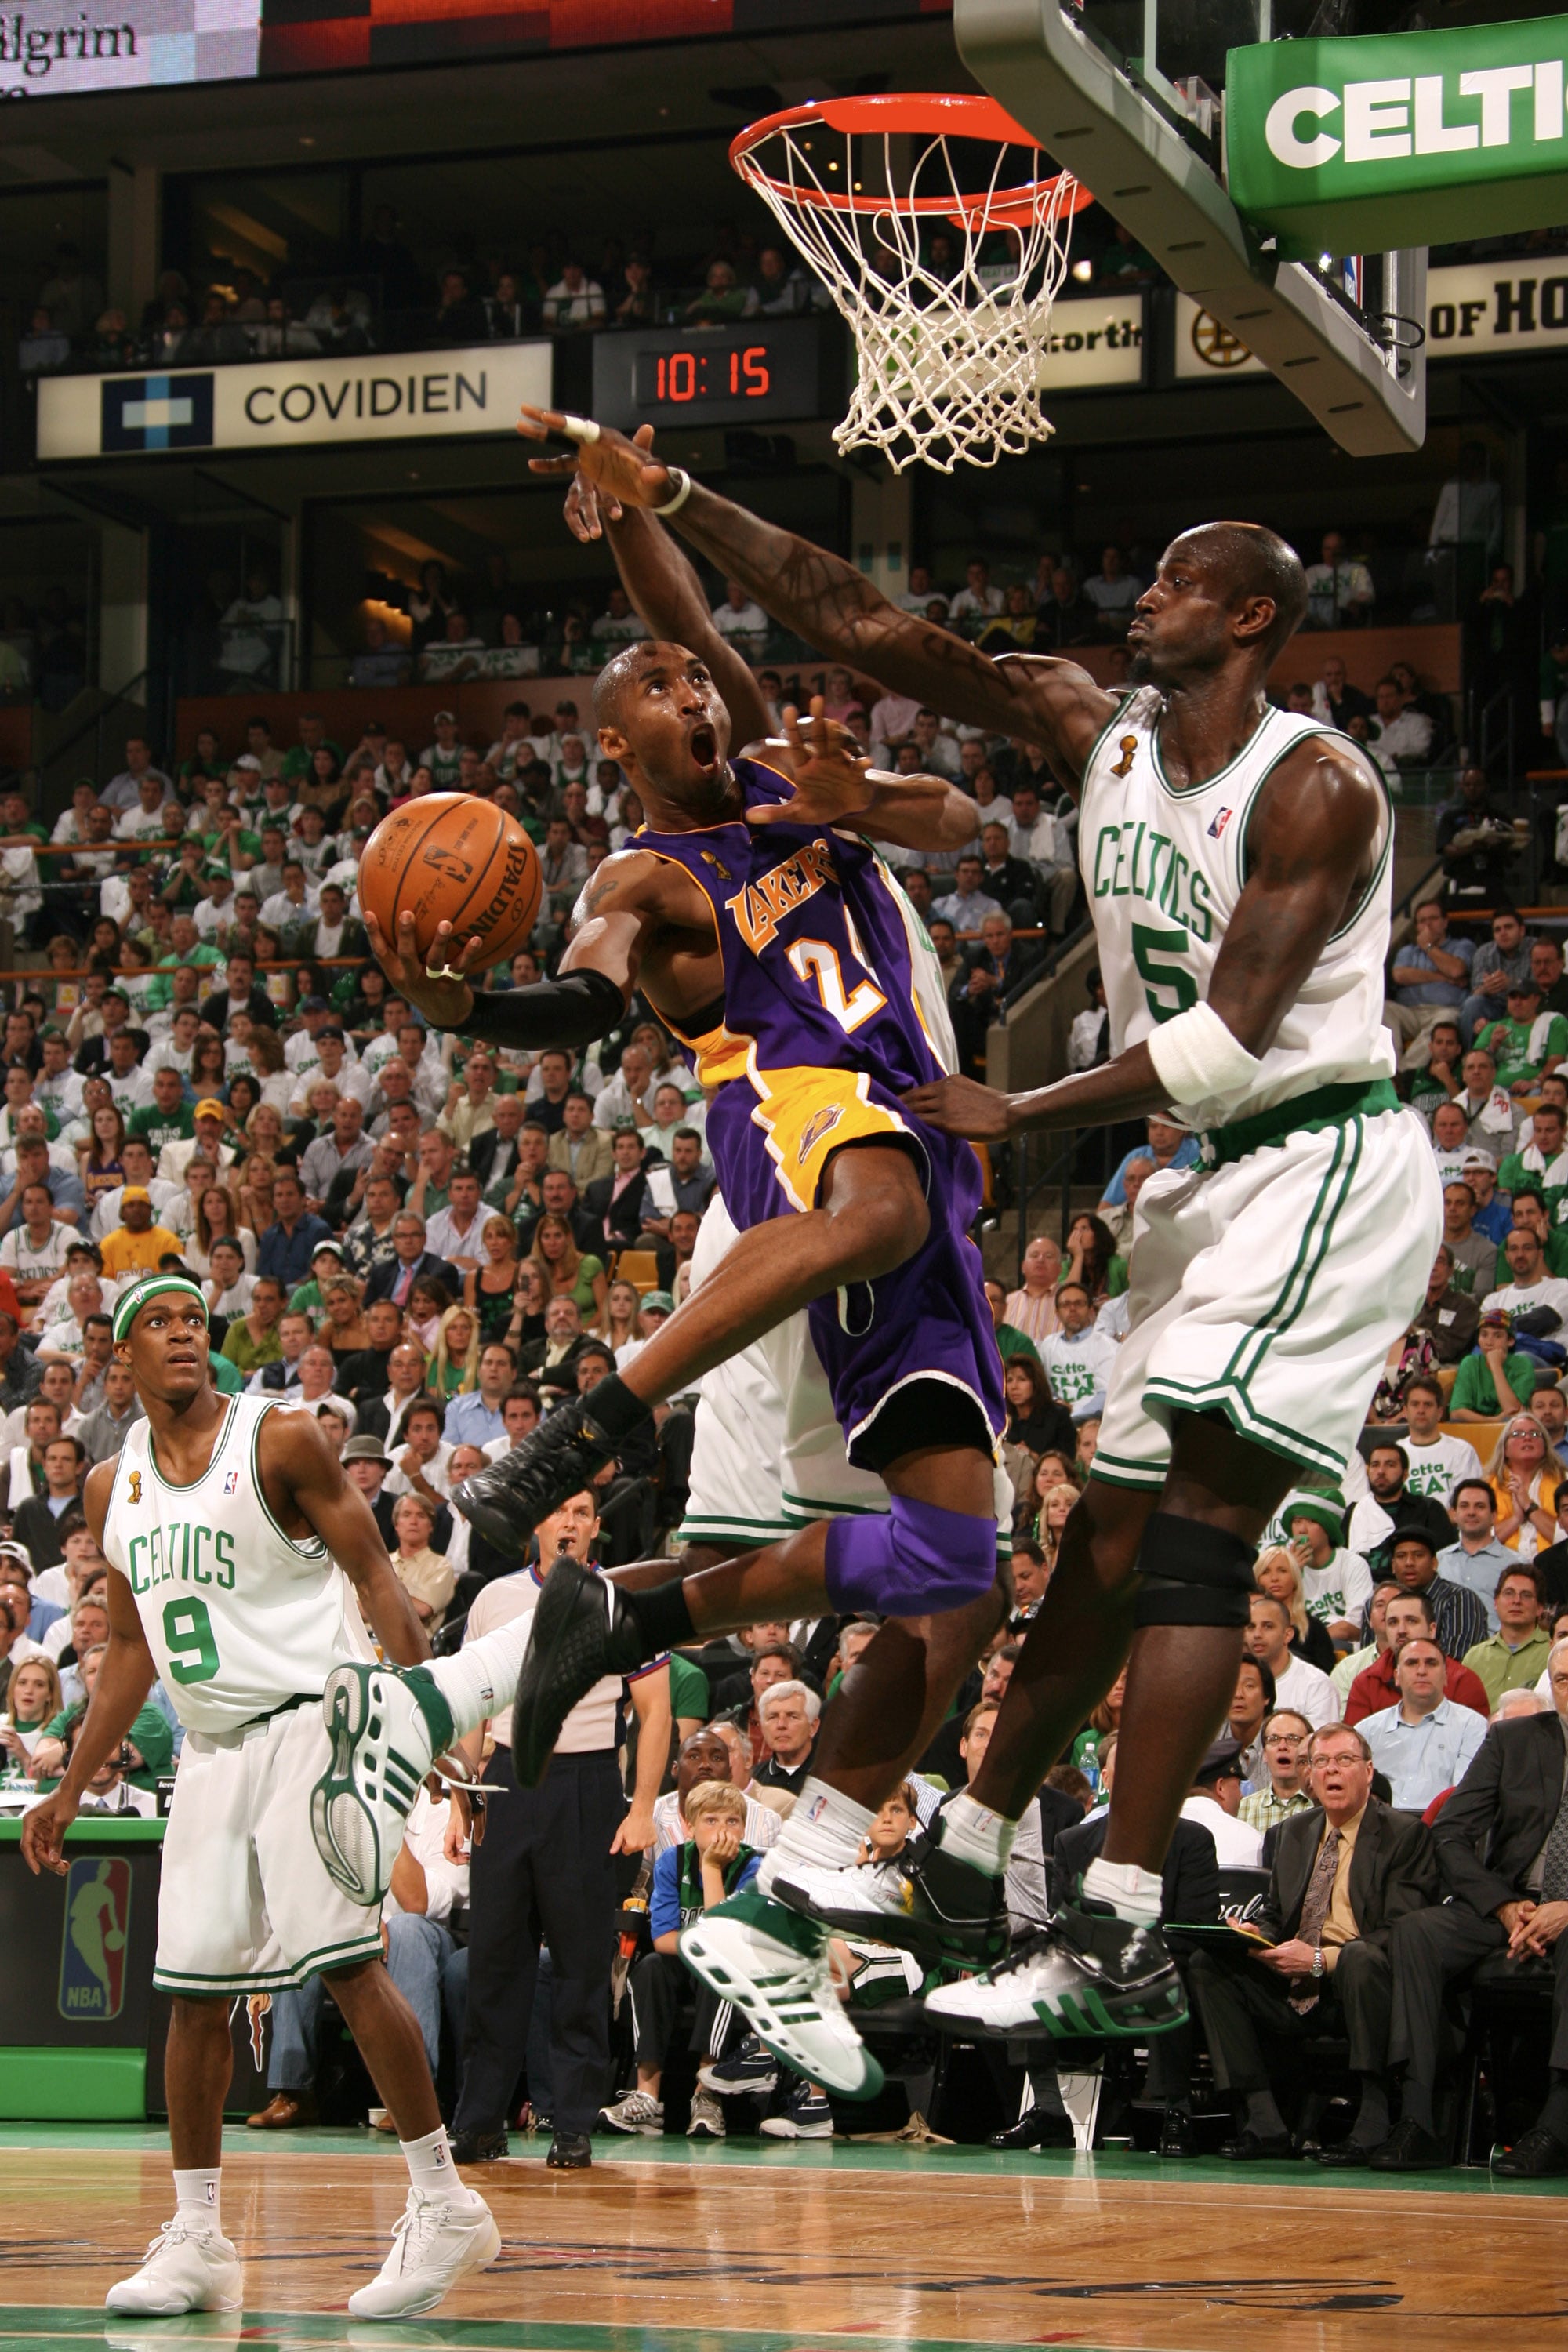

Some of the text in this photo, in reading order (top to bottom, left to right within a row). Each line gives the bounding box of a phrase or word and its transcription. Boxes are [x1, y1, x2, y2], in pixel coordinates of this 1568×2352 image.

[1265, 60, 1568, 169] CELTI
[1430, 302, 1486, 339] OF
[245, 370, 486, 425] COVIDIEN
[657, 347, 770, 402] 10:15
[725, 838, 840, 959] LAKERS
[1094, 822, 1212, 943] CELTICS
[1131, 921, 1200, 1024] 5
[1408, 1472, 1454, 1497] EAT
[1410, 1463, 1444, 1477] otta
[129, 1523, 235, 1595] CELTICS
[162, 1596, 220, 1685] 9
[67, 1986, 102, 2008] NBA
